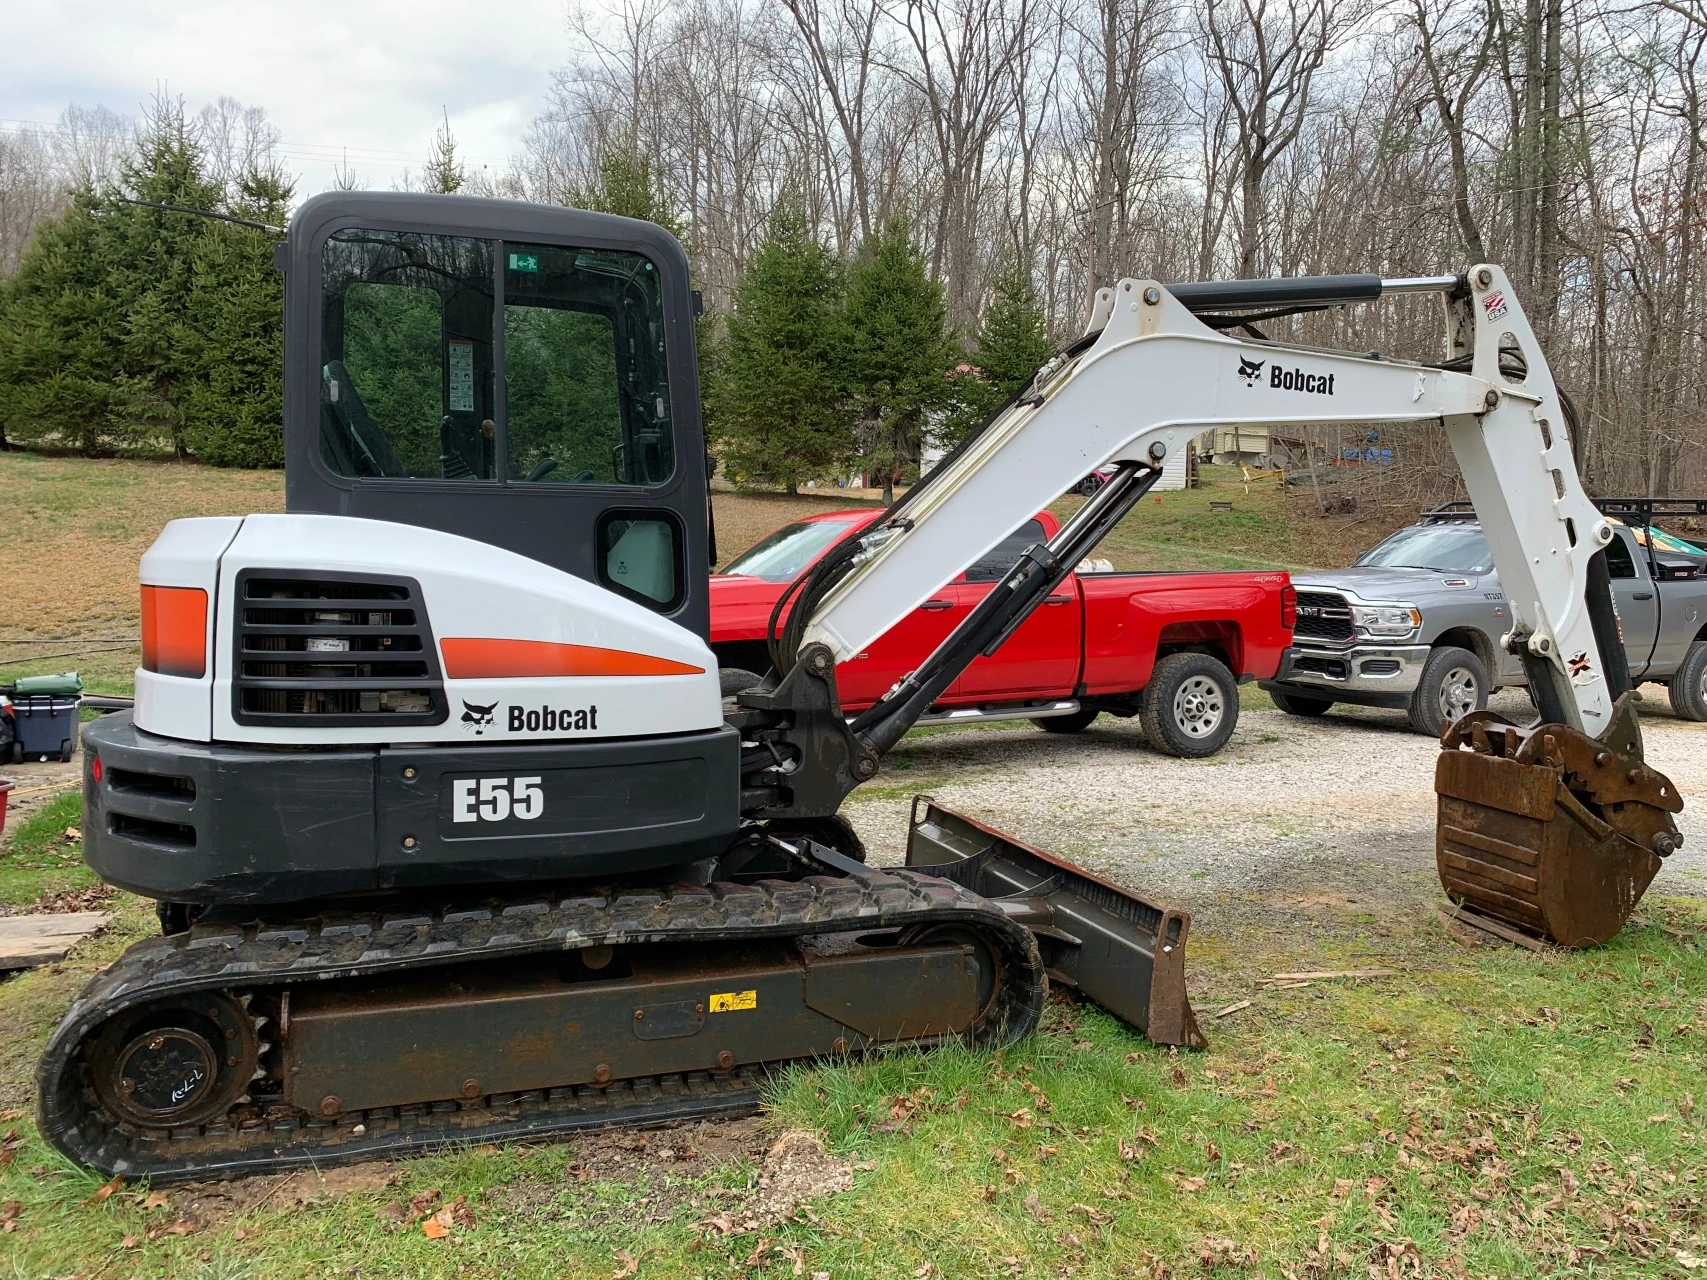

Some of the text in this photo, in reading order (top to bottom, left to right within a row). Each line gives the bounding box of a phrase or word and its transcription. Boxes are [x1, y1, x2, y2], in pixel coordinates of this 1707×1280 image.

[1489, 307, 1507, 320] USA
[1270, 365, 1334, 395] Bobcat
[1296, 607, 1318, 616] AM
[508, 705, 597, 732] Bobcat
[453, 776, 544, 823] E55
